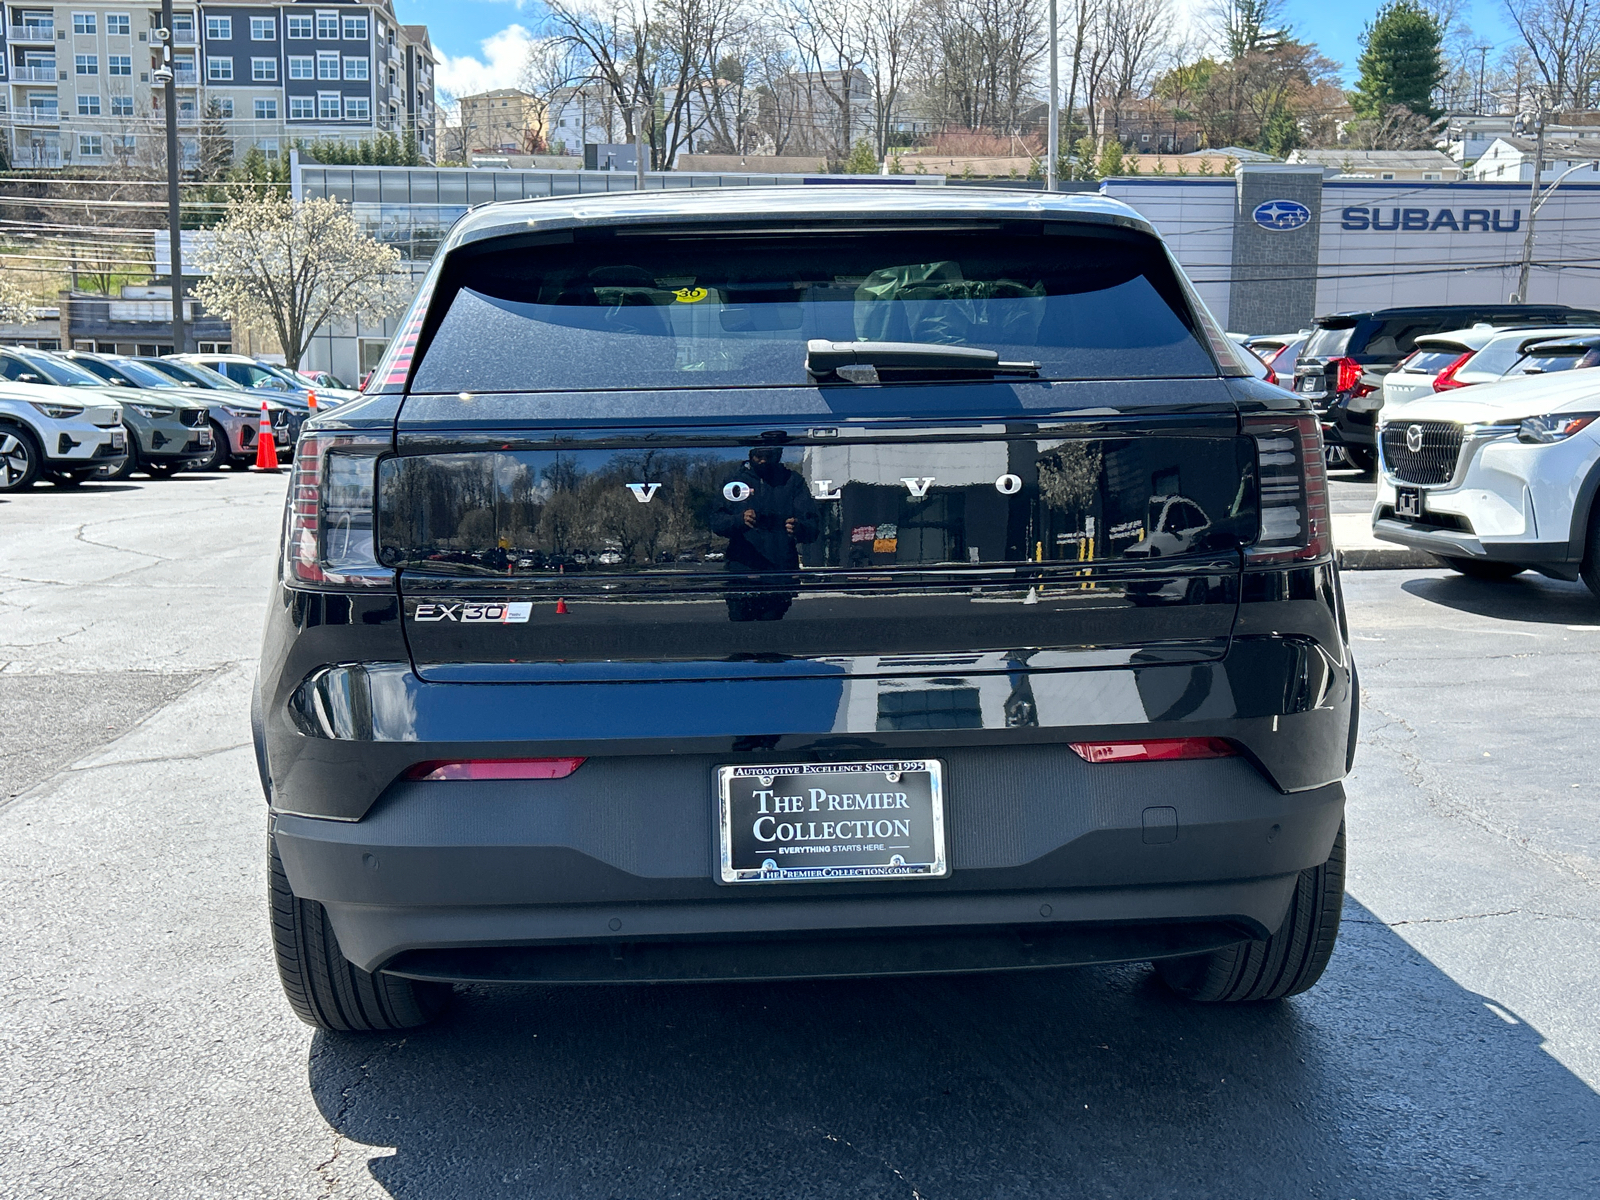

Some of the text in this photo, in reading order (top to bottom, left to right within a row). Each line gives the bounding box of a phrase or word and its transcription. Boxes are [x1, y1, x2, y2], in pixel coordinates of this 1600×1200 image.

[1341, 206, 1521, 233] SUBARU
[626, 473, 1022, 503] VOLVO
[736, 761, 925, 776] AUTOMOTIVE EXCELLENCE SINCE 1995
[752, 788, 910, 814] THE PREMIER
[752, 816, 911, 842] COLLECTION
[778, 846, 831, 855] EVERYTHING
[832, 845, 862, 853] STARTS
